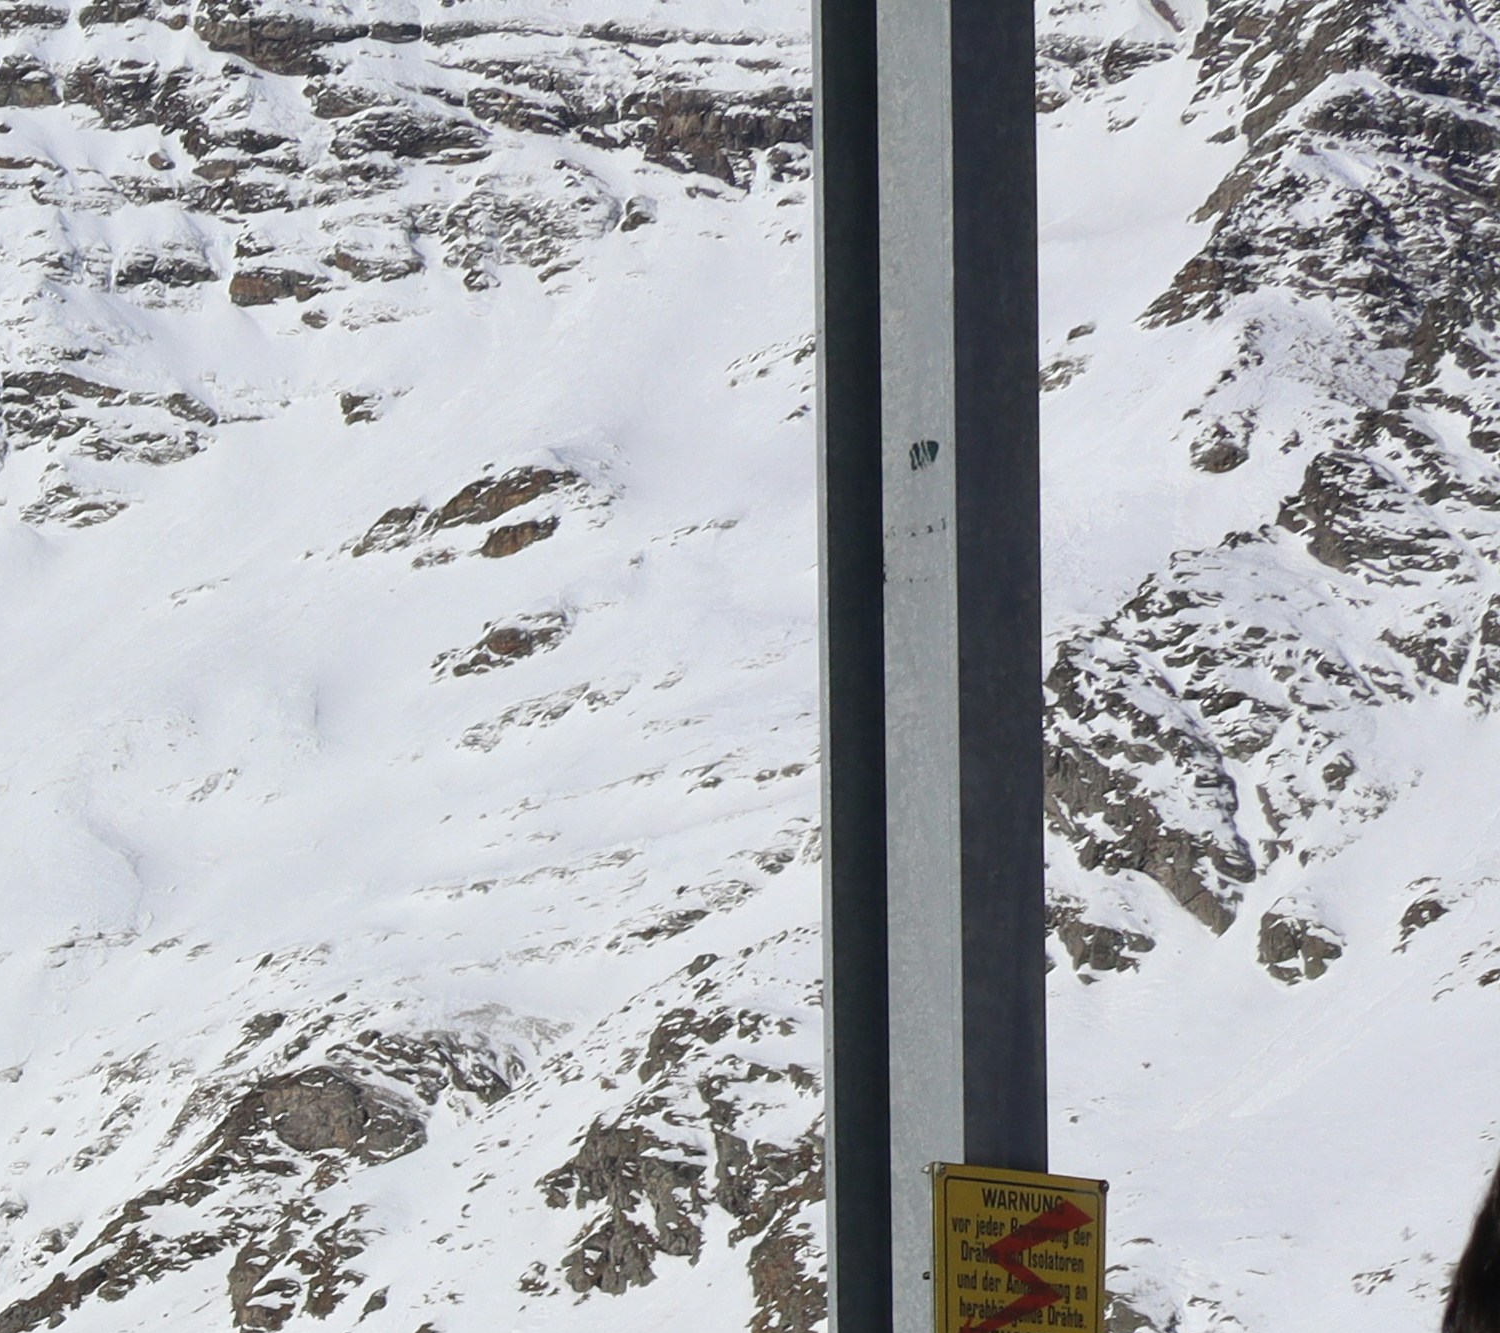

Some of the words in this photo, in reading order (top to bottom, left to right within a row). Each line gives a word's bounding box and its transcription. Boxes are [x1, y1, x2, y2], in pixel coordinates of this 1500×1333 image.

[982, 1187, 1065, 1214] WARNUNG
[952, 1216, 971, 1233] vor
[975, 1214, 1006, 1239] jeder
[1073, 1227, 1092, 1247] der
[1028, 1247, 1085, 1273] Isolatoren
[957, 1269, 977, 1290] und
[982, 1270, 1002, 1293] der
[1075, 1285, 1088, 1301] an
[1048, 1304, 1088, 1329] Drähte.
